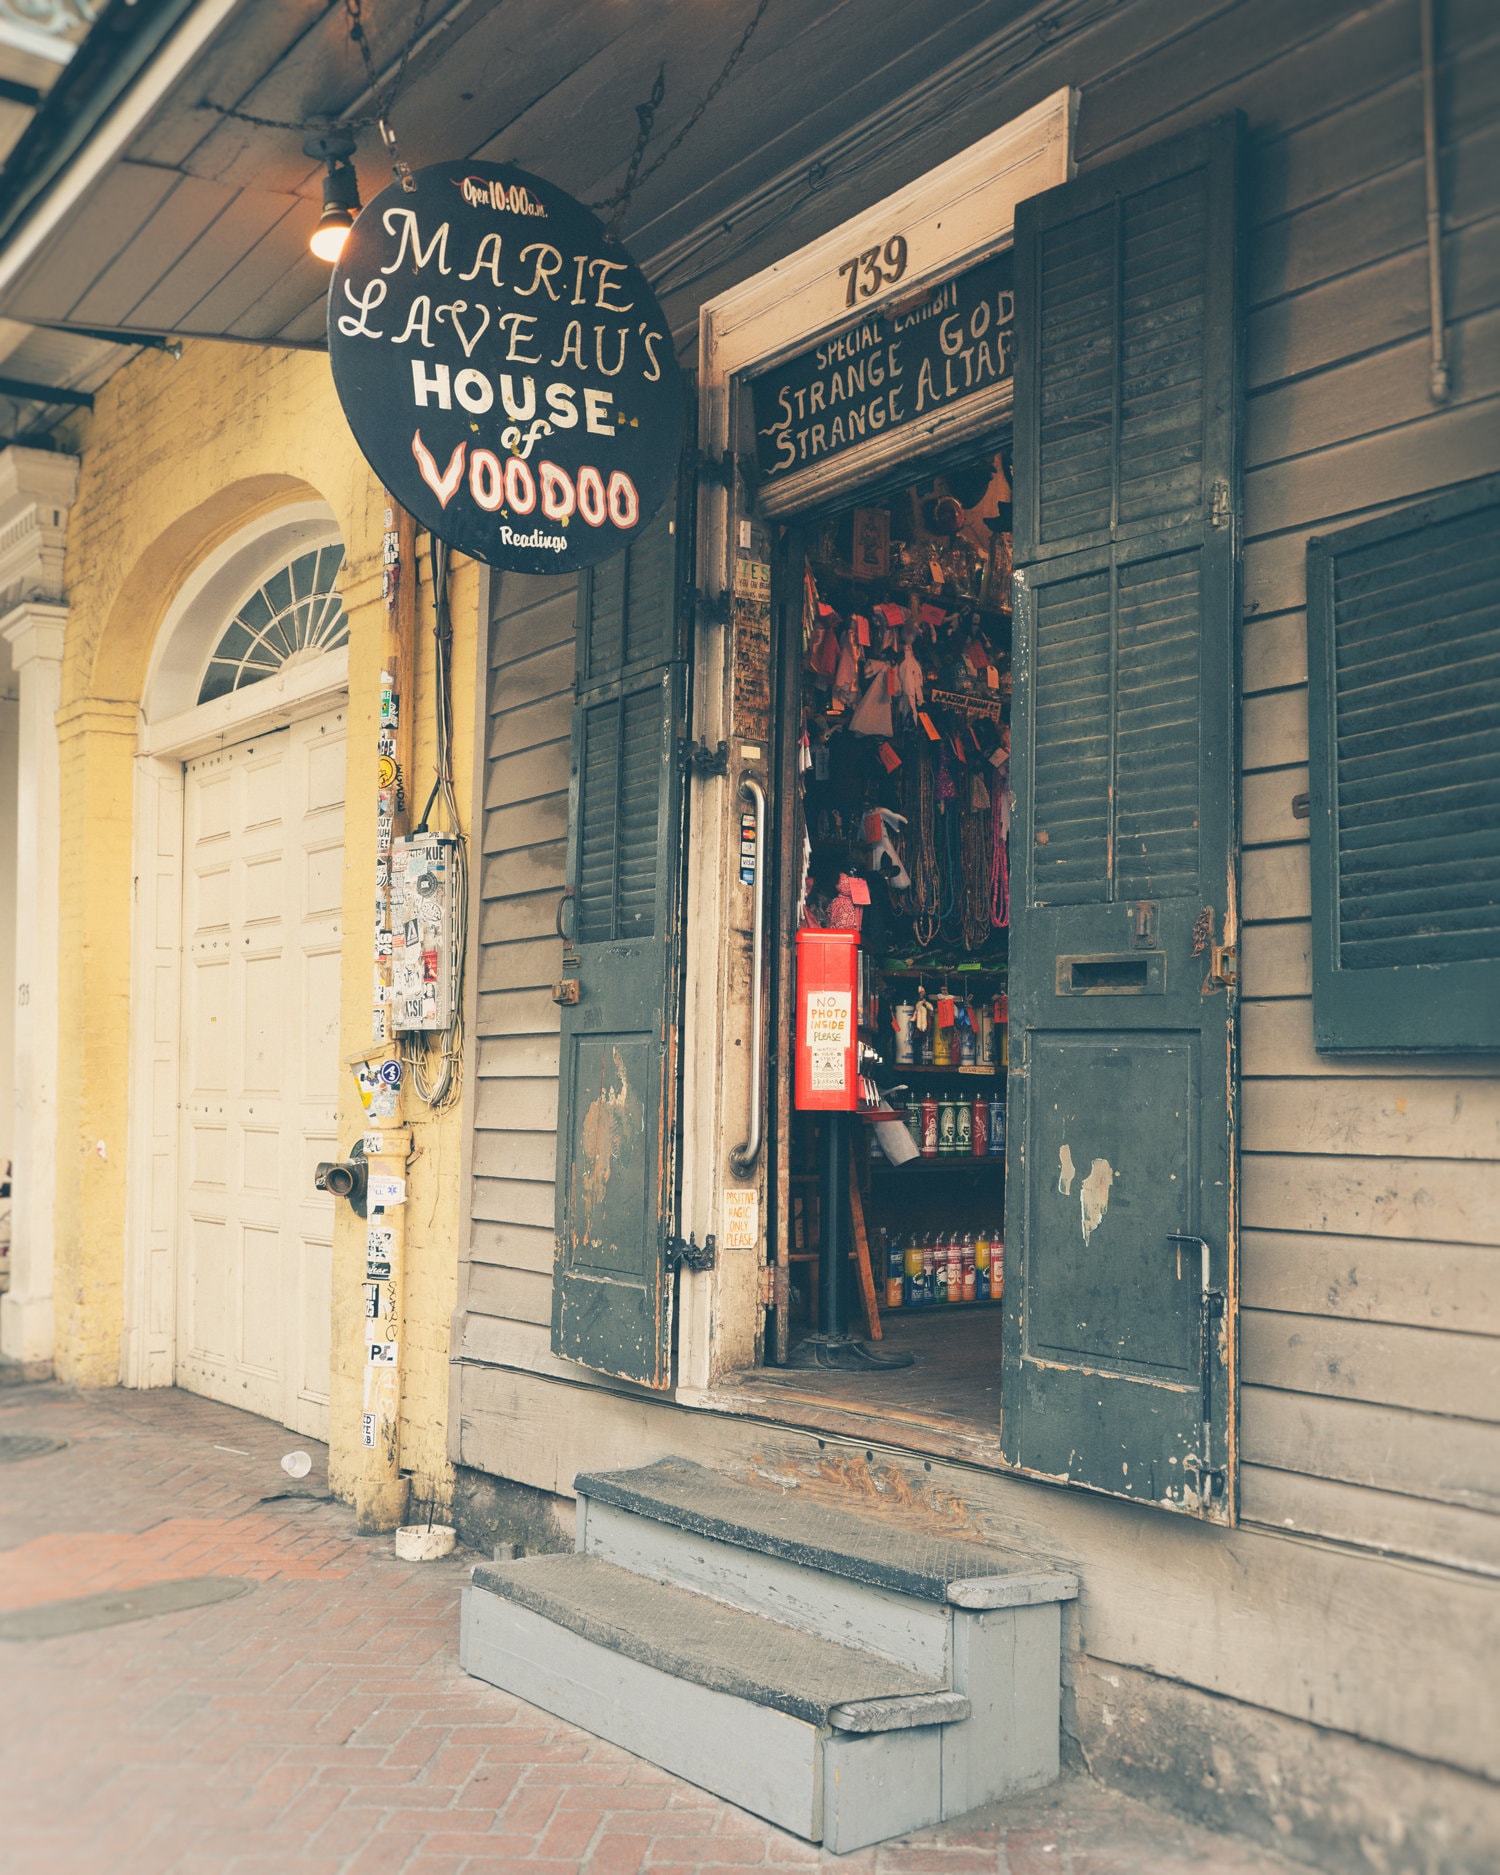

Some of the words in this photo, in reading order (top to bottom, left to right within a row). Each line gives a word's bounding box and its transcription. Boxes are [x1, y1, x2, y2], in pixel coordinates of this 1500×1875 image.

[463, 177, 489, 208] Open
[381, 207, 634, 313] MARIE
[838, 235, 908, 307] 739
[337, 278, 663, 382] LAVEAU'S
[816, 321, 883, 370] SPECIAL
[411, 359, 616, 436] HOUSE
[759, 341, 904, 435] STRANGE
[501, 419, 555, 459] of
[765, 384, 904, 474] STRANGE
[412, 428, 640, 530] VOODOO
[500, 525, 568, 553] Readings
[742, 562, 769, 582] YES
[811, 1008, 848, 1019] PHOTO
[816, 996, 836, 1008] NO
[811, 1020, 845, 1030] INSIDE
[726, 1233, 754, 1247] PLEASE
